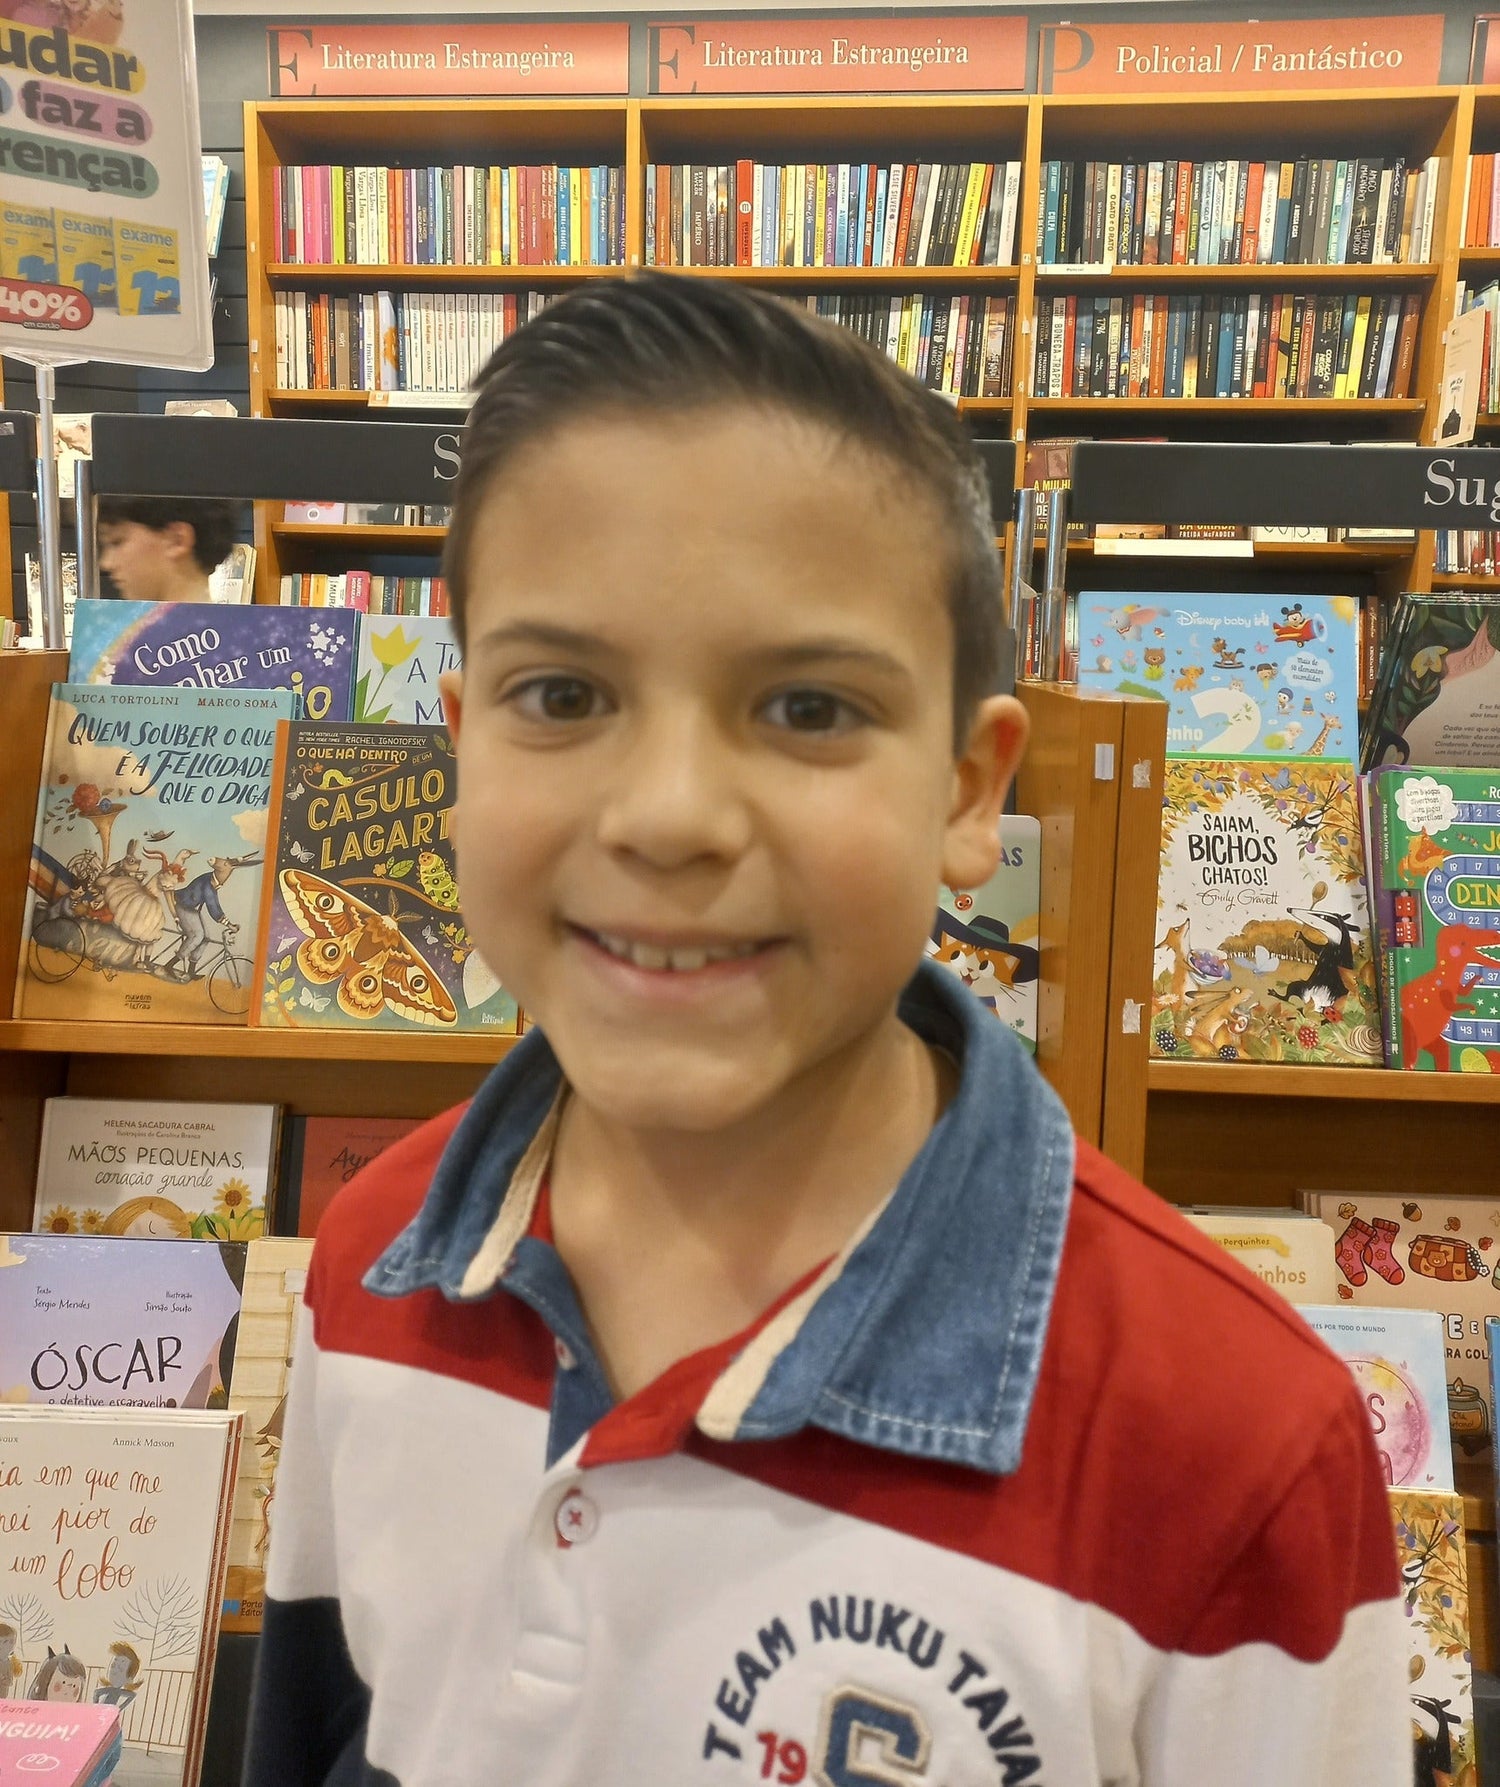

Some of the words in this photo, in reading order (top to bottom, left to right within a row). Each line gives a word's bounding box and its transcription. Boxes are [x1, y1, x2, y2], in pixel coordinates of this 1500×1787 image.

[0, 25, 138, 93] udar
[321, 43, 436, 70] Literatura
[443, 43, 575, 76] Estrangeira
[702, 40, 823, 67] Literatura
[830, 38, 969, 72] Estrangeira
[1116, 44, 1222, 74] Policial
[1253, 41, 1403, 73] Fantástico
[21, 79, 103, 133] faz
[115, 106, 147, 142] a
[892, 169, 900, 188] ELSIE
[1356, 164, 1368, 201] IMAGINÁRIO
[1367, 170, 1377, 192] AMIGO
[889, 190, 898, 213] SILVER
[695, 211, 703, 246] IMPÉRIO
[1047, 211, 1056, 231] CULPA
[120, 226, 174, 247] exame
[1360, 229, 1371, 255] STEPHEN
[1096, 317, 1106, 335] 1794
[1293, 327, 1301, 343] FESTA
[1053, 323, 1063, 354] BONECA
[930, 344, 938, 366] AMIGO
[934, 351, 943, 380] PEQUENO
[1109, 353, 1118, 369] VERÃO
[1291, 351, 1299, 364] ANOS
[1318, 353, 1326, 377] NEGRO
[1323, 349, 1332, 381] CORAÇÃO
[1051, 358, 1062, 388] TRAPOS
[1366, 363, 1375, 381] Justiça
[1180, 530, 1201, 538] FREIDA
[1203, 530, 1235, 538] McFADDEN
[1174, 609, 1222, 631] Disney
[1224, 616, 1251, 629] baby
[134, 627, 221, 677] Como
[407, 656, 427, 684] A
[73, 694, 106, 704] LUCA
[111, 695, 179, 706] TORTOLINI
[197, 697, 241, 708] MARCO
[68, 712, 131, 746] QUEM
[130, 721, 218, 748] SOUBER
[223, 728, 237, 746] O
[240, 727, 276, 747] QUE
[345, 735, 376, 745] RACHEL
[378, 736, 427, 747] IGNOTOFSKY
[115, 750, 133, 777] É
[132, 753, 151, 777] A
[297, 747, 306, 757] O
[308, 748, 333, 760] QUE
[336, 746, 358, 760] HÁ
[360, 749, 408, 764] DENTRO
[130, 749, 273, 796] FELICIDADE
[158, 782, 197, 805] QUE
[202, 785, 215, 804] O
[218, 781, 271, 807] DIGA
[307, 769, 446, 831] CASULO
[1202, 813, 1261, 835] SAIAM,
[320, 806, 452, 870] LAGART
[1188, 834, 1279, 866] BICHOS
[1202, 866, 1270, 887] CHATOS!
[1475, 862, 1483, 871] 17
[1196, 888, 1236, 912] Emily
[1236, 889, 1280, 907] Gravett
[1432, 895, 1444, 904] 20
[1448, 911, 1457, 920] 21
[1468, 916, 1481, 925] 22
[1388, 952, 1396, 975] JOGOS
[1487, 972, 1499, 981] 37
[1390, 988, 1398, 1040] DINOSSAUROS
[1460, 1026, 1473, 1035] 43
[1480, 1028, 1493, 1037] 44
[104, 1119, 136, 1128] HELENA
[137, 1120, 182, 1130] SACADURA
[183, 1122, 215, 1131] CABRAL
[68, 1141, 126, 1165] MÃOS
[137, 1146, 246, 1171] PEQUENAS,
[95, 1169, 152, 1187] coração
[161, 1171, 214, 1195] grande
[1222, 1236, 1270, 1248] Porquinhos
[36, 1286, 52, 1295] Texto
[165, 1290, 193, 1300] Ilustração
[33, 1297, 57, 1312] Sérgio
[58, 1298, 91, 1311] Mendes
[144, 1301, 169, 1313] Simão
[170, 1301, 193, 1313] Souto
[1338, 1324, 1355, 1332] TODO
[1362, 1325, 1386, 1333] MUNDO
[31, 1335, 183, 1391] ÓSCAR
[60, 1393, 104, 1408] detetive
[109, 1393, 177, 1409] escaravelho
[112, 1436, 142, 1447] Annick
[144, 1437, 175, 1448] Masson
[33, 1465, 72, 1486] em
[85, 1466, 119, 1500] que
[129, 1470, 163, 1494] me
[51, 1502, 111, 1545] pior
[129, 1506, 157, 1535] do
[8, 1553, 47, 1575] um
[53, 1536, 136, 1601] lobo
[240, 1600, 263, 1609] Porto
[702, 1617, 797, 1761] TEAM
[810, 1595, 945, 1669] NUKU
[756, 1731, 808, 1786] 19
